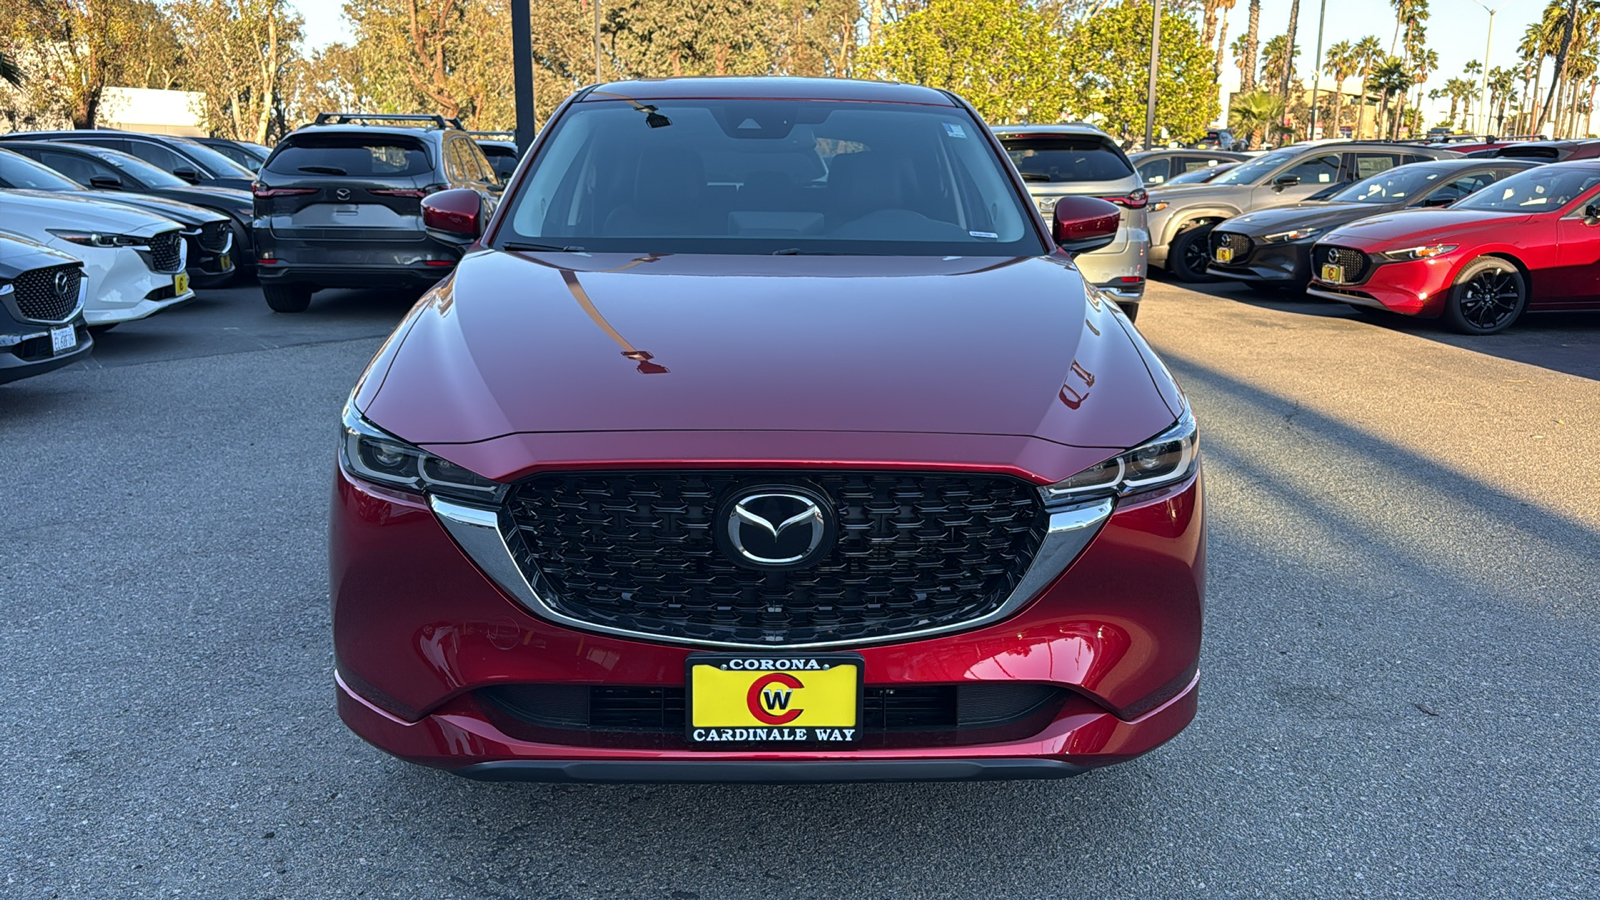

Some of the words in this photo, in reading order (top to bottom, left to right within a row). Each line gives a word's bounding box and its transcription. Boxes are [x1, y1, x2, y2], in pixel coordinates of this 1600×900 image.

[729, 659, 821, 670] CORONA
[693, 729, 807, 741] CARDINALE
[815, 729, 856, 741] WAY
